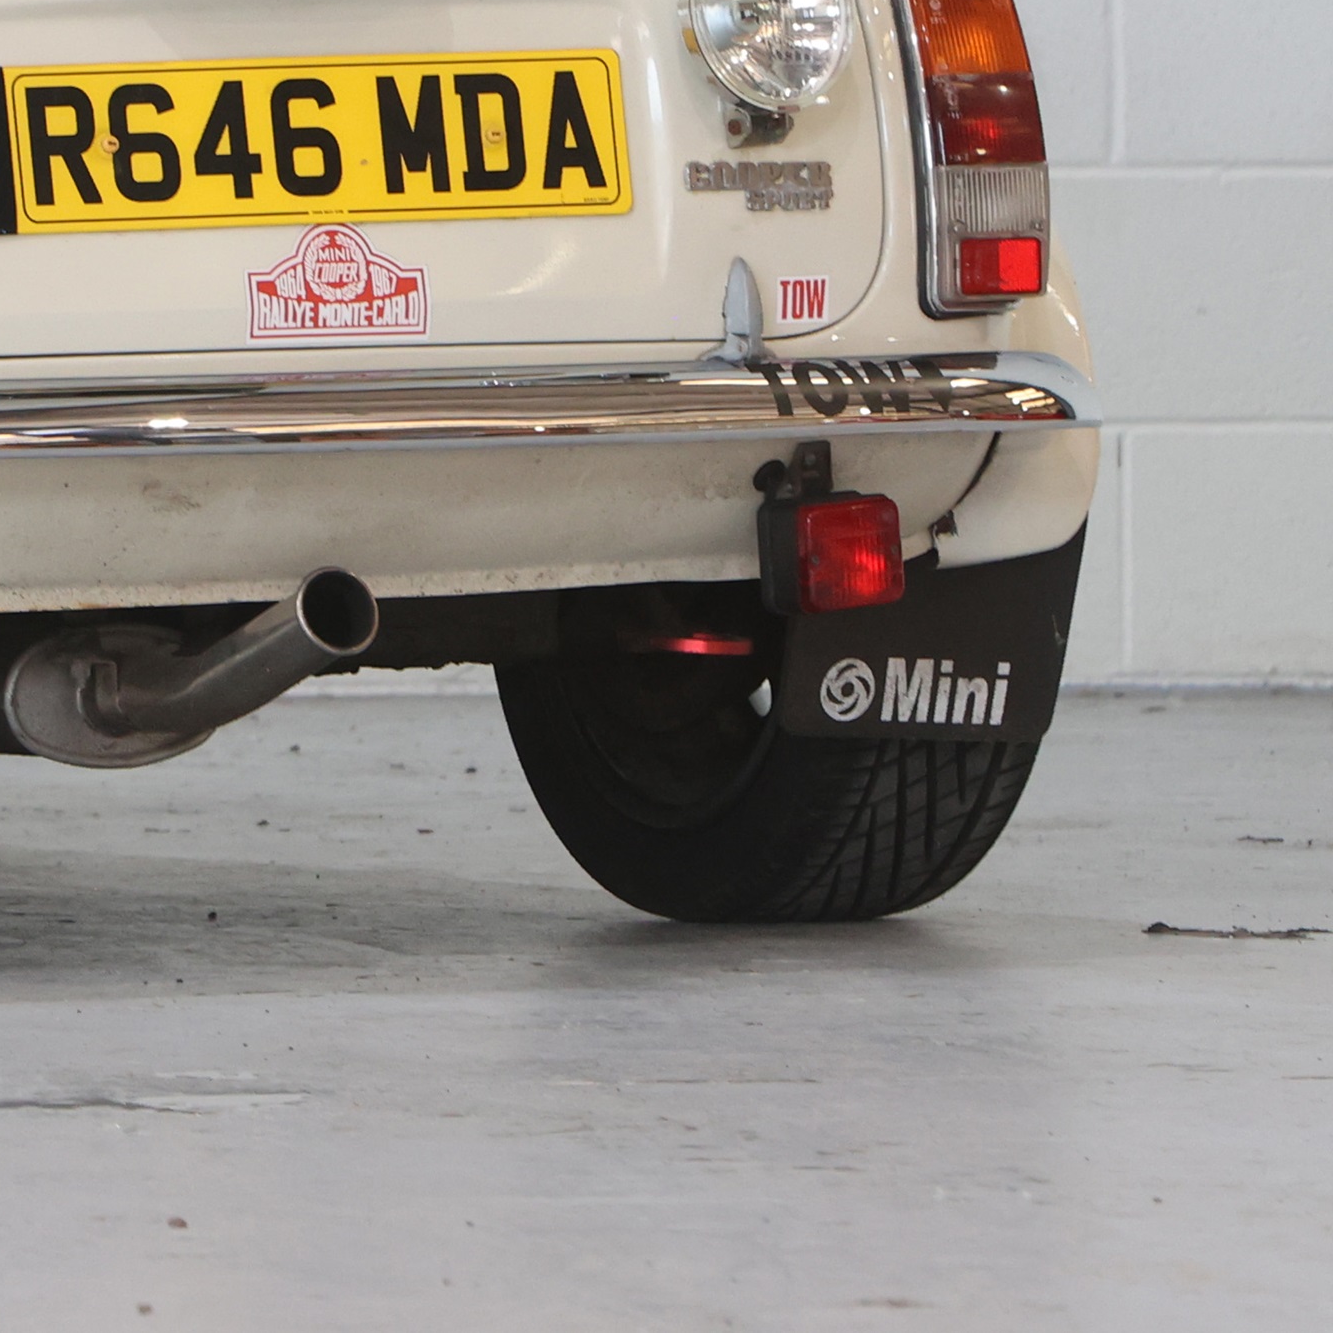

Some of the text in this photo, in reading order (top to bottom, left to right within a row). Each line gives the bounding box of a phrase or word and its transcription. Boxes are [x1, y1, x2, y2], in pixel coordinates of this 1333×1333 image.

[24, 70, 607, 207] R646 MDA
[314, 261, 359, 284] COOPER
[317, 247, 352, 262] MINI
[275, 264, 307, 299] 1964
[369, 262, 398, 297] 1967
[780, 278, 826, 320] TOW
[258, 290, 419, 331] RALLYE MONTE-CARLO
[744, 359, 910, 417] TOW
[880, 657, 1011, 726] Mini
